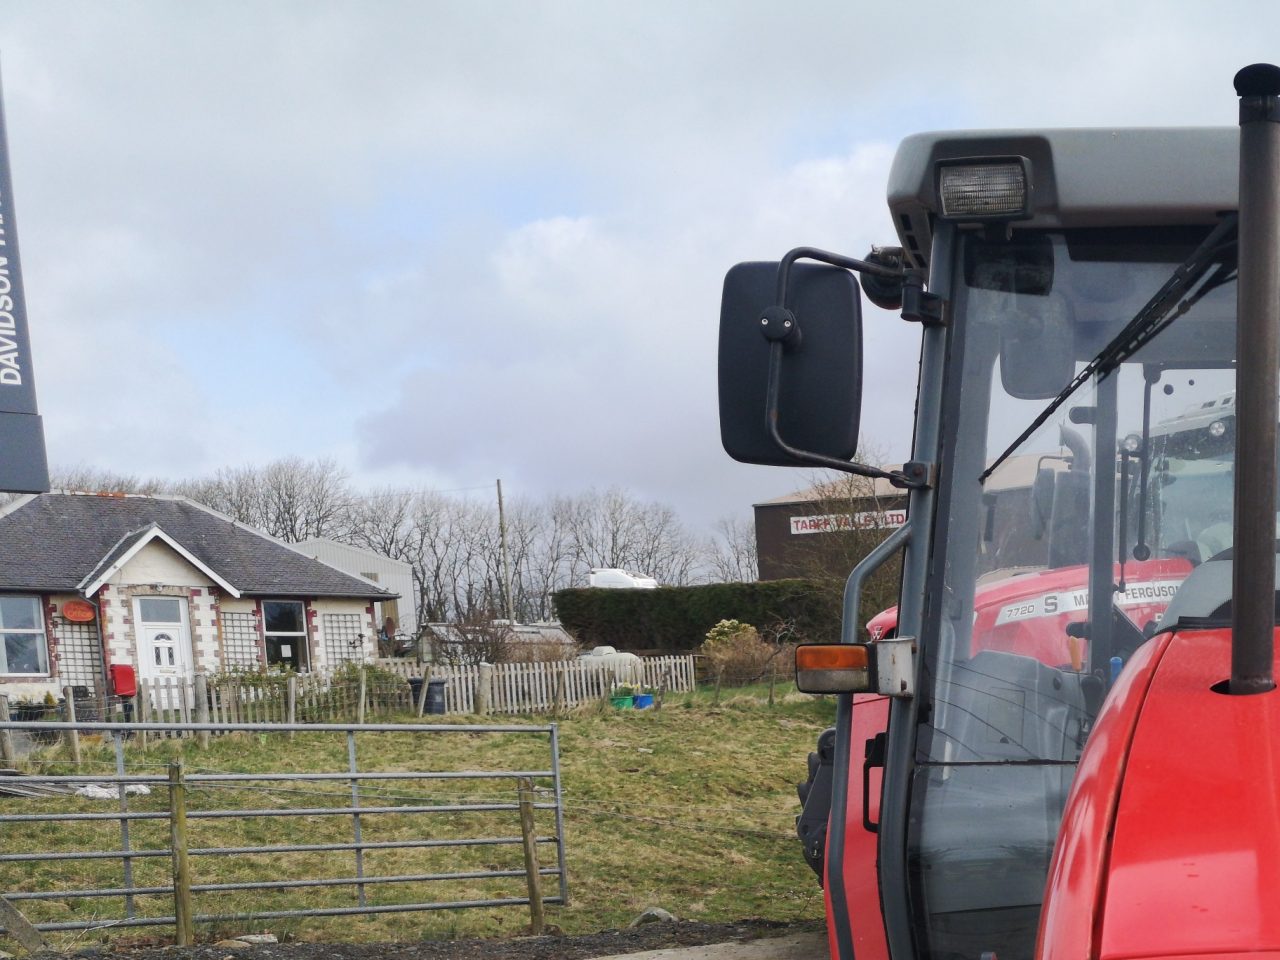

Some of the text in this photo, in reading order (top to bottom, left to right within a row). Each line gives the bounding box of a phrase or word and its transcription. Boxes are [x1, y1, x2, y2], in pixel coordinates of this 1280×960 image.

[884, 513, 905, 525] LTD
[1007, 605, 1035, 618] 7720
[1044, 595, 1058, 613] S
[1125, 585, 1178, 600] FERGUSO
